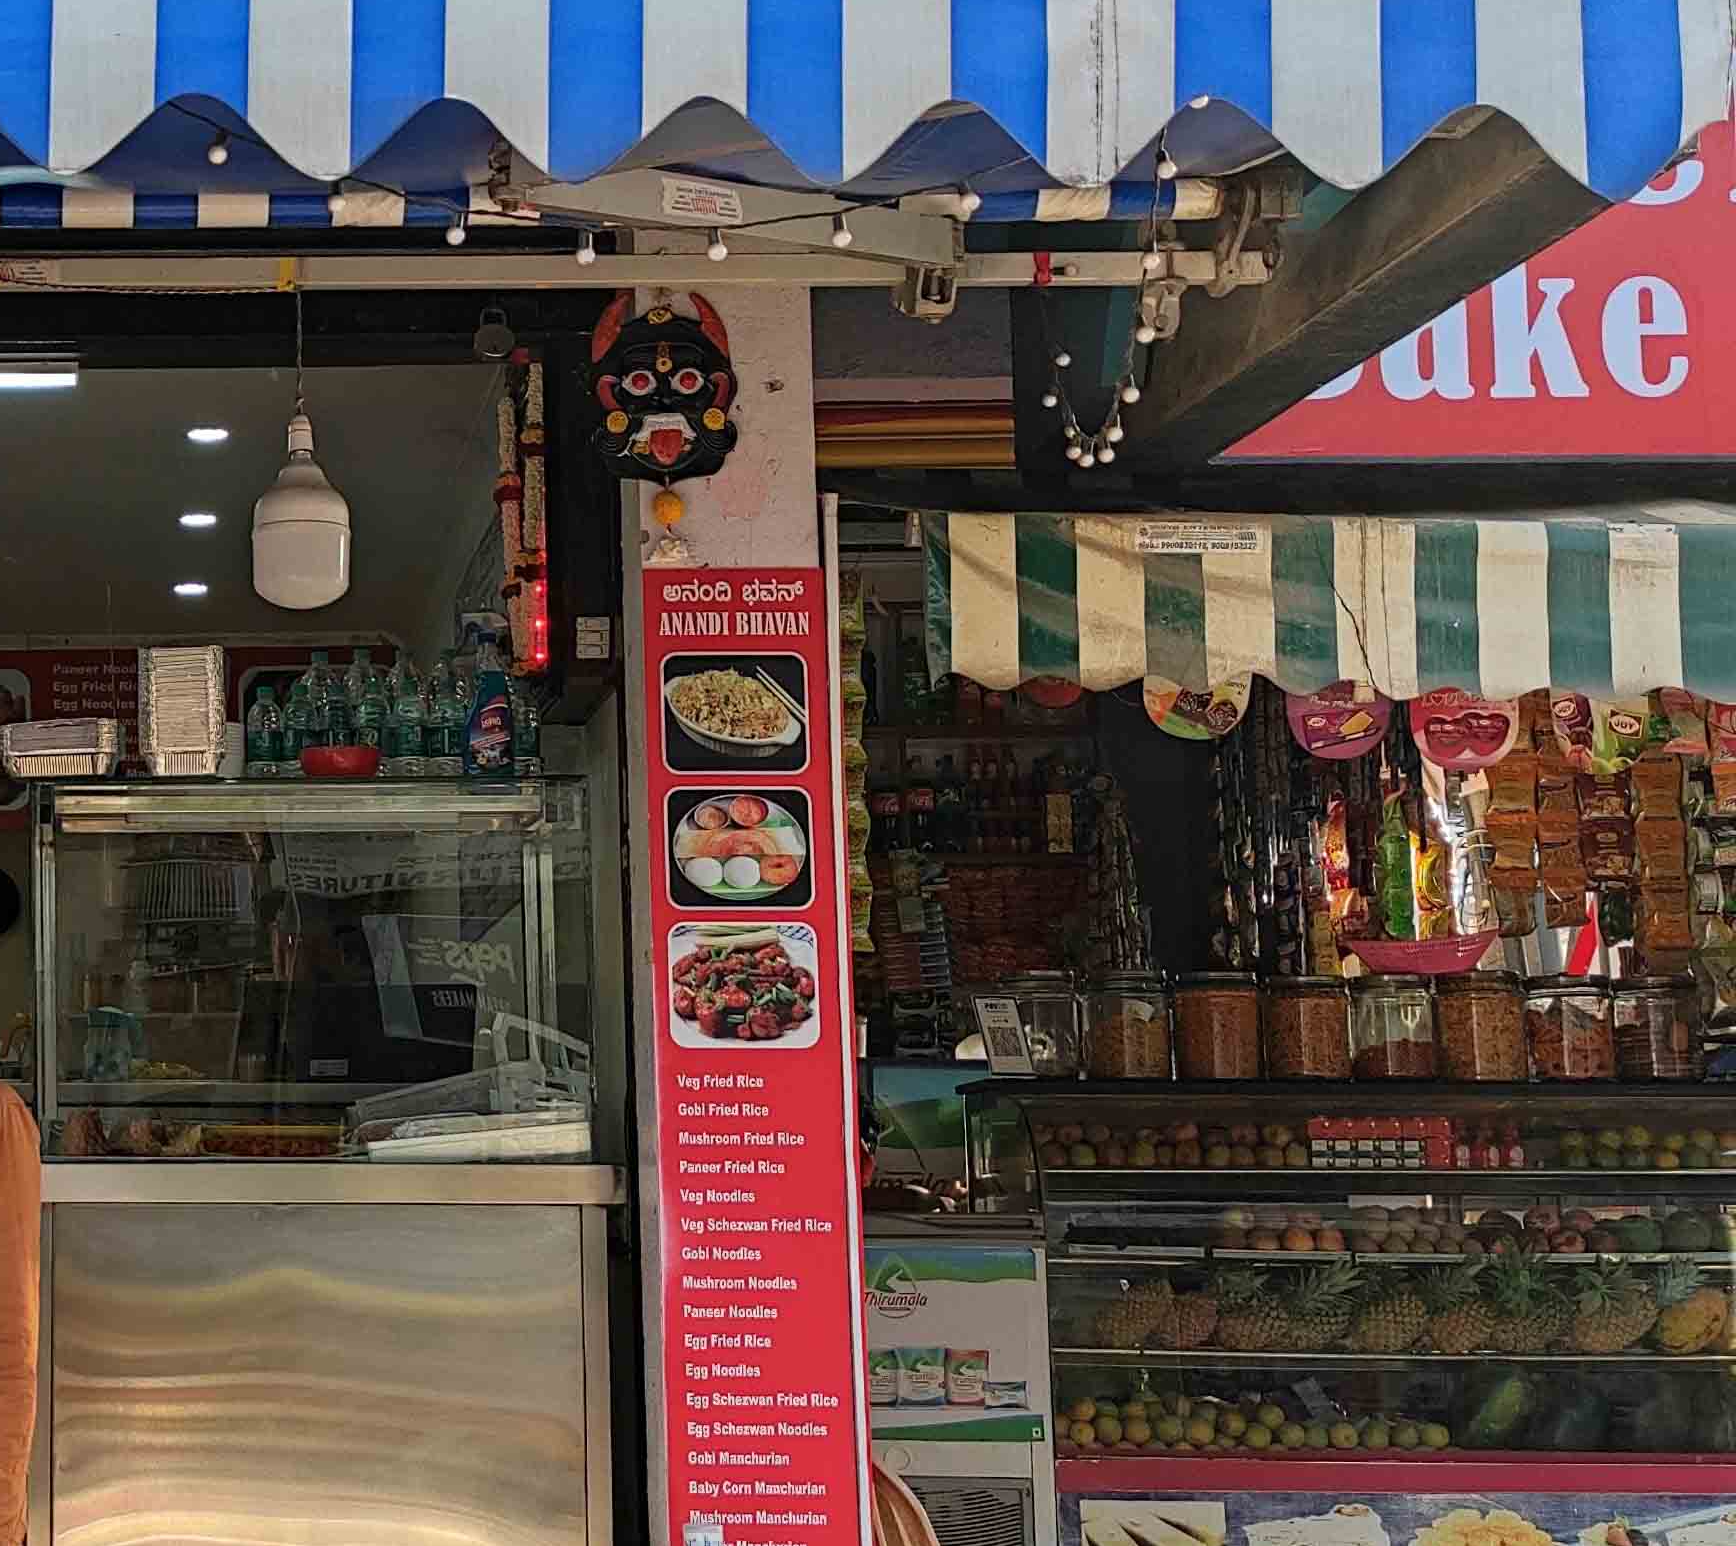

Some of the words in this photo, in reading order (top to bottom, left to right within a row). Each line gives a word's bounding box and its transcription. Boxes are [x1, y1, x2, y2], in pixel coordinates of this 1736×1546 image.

[1304, 262, 1690, 401] ake
[662, 577, 732, 602] ಅನಂದಿ
[742, 577, 804, 606] ಭವನ್
[659, 611, 729, 636] ANANDI
[735, 611, 809, 636] BHAVAN
[676, 1074, 701, 1091] Veg
[704, 1074, 734, 1088] Fried
[737, 1074, 765, 1088] Rice
[678, 1103, 705, 1117] Gobi
[709, 1103, 739, 1117] Fried
[743, 1103, 769, 1117] Rice
[679, 1132, 741, 1145] Mushroom
[744, 1132, 774, 1145] Fried
[777, 1132, 805, 1145] Rice
[679, 1160, 722, 1174] Paneer
[724, 1160, 755, 1174] Fried
[758, 1160, 785, 1174] Rice
[680, 1189, 704, 1206] Veg
[706, 1189, 756, 1203] Noodles
[681, 1218, 705, 1235] Veg
[707, 1218, 768, 1232] Schezwan
[771, 1218, 801, 1232] Fried
[805, 1218, 832, 1232] Rice
[682, 1247, 710, 1261] Gobi
[712, 1247, 762, 1261] Noodles
[683, 1276, 745, 1290] Mushroom
[748, 1276, 798, 1290] Noodles
[864, 1291, 928, 1308] Thirumala
[683, 1304, 725, 1318] Paneer
[729, 1304, 778, 1318] Noodles
[684, 1334, 708, 1350] Egg
[711, 1334, 741, 1347] Fried
[744, 1334, 772, 1347] Rice
[685, 1364, 709, 1380] Egg
[712, 1364, 761, 1377] Noodles
[686, 1393, 710, 1410] Egg
[712, 1393, 774, 1407] Schezwan
[777, 1393, 807, 1407] Fried
[811, 1393, 839, 1407] Rice
[688, 1422, 710, 1438] Egg
[713, 1422, 774, 1435] Schezwan
[778, 1422, 828, 1435] Noodles
[688, 1451, 716, 1465] Gobi
[719, 1451, 791, 1465] Manchurian
[689, 1481, 720, 1497] Baby
[722, 1481, 752, 1494] Corn
[755, 1481, 826, 1494] Manchurian
[690, 1510, 753, 1525] Mushroom
[756, 1510, 827, 1525] Manchurian
